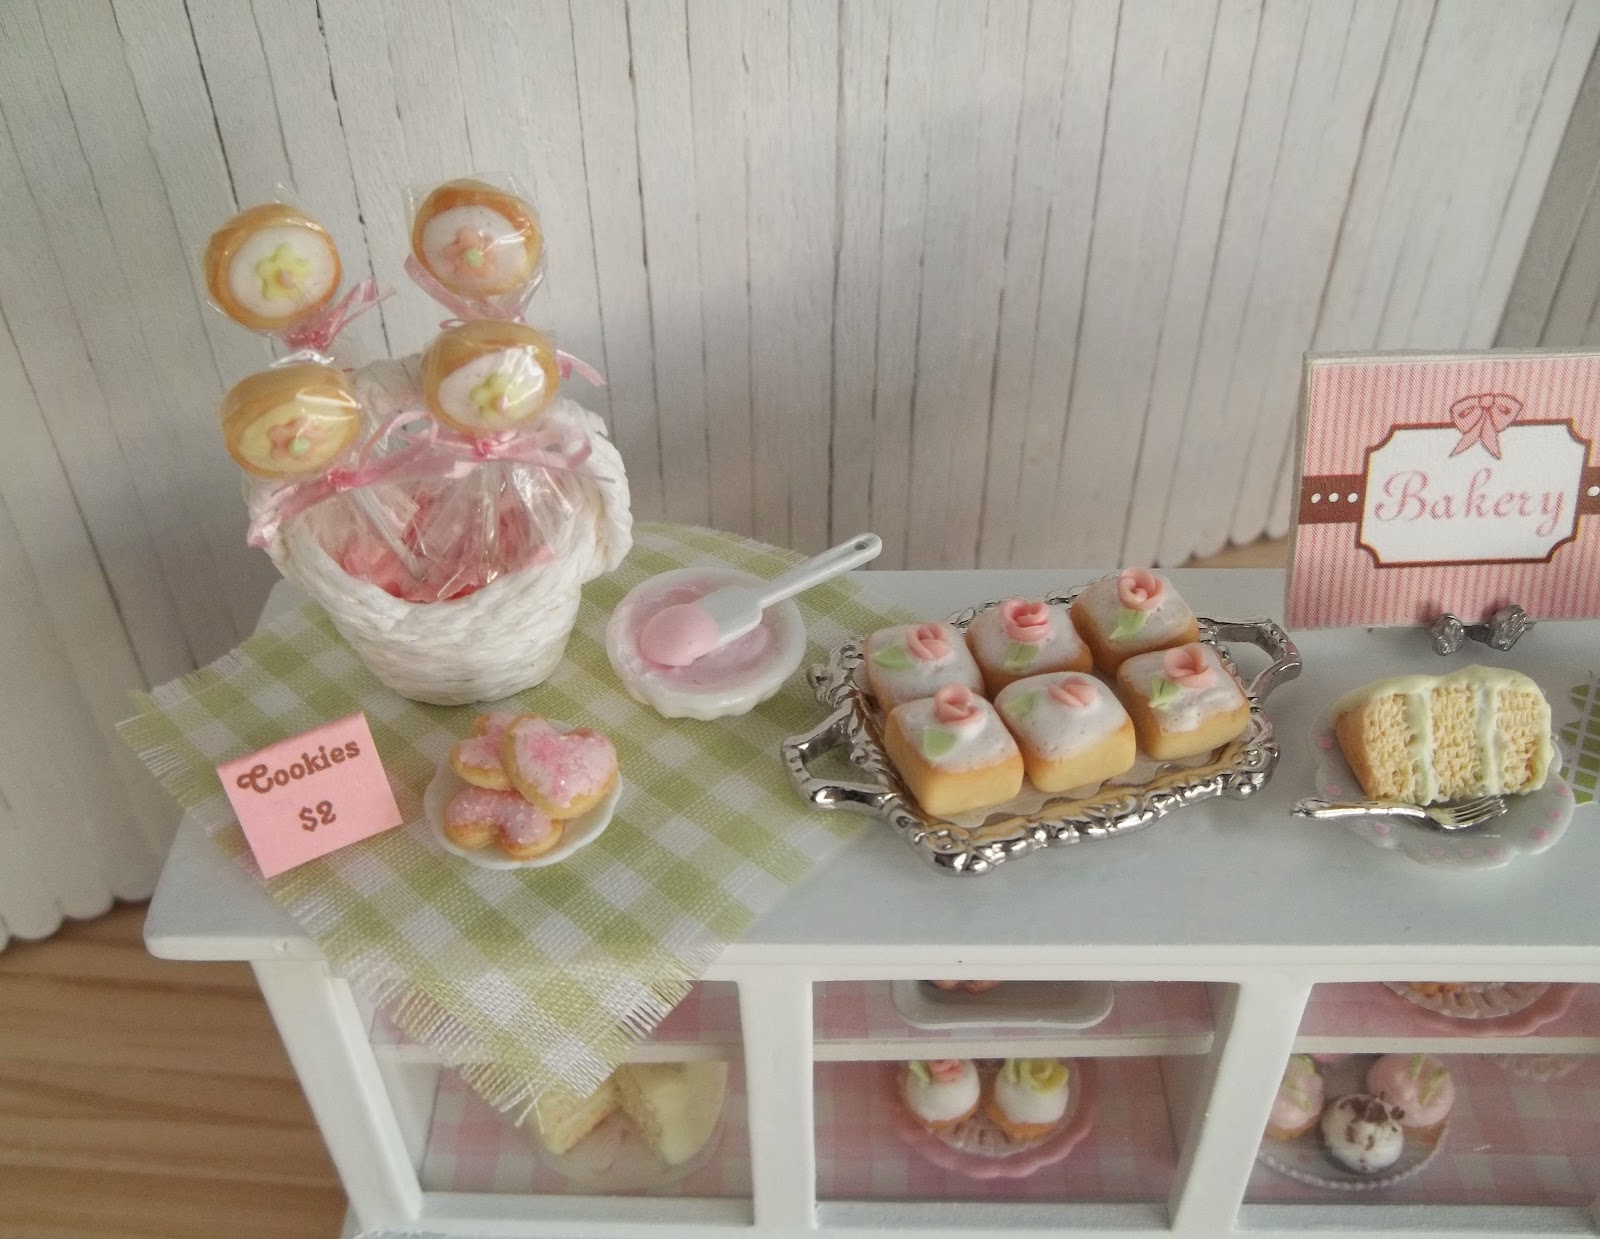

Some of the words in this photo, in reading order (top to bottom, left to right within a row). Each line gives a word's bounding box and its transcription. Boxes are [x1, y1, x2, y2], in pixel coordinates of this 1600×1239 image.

[1374, 467, 1565, 537] Bakery
[236, 740, 361, 794] Cookies
[298, 800, 337, 833] $2
